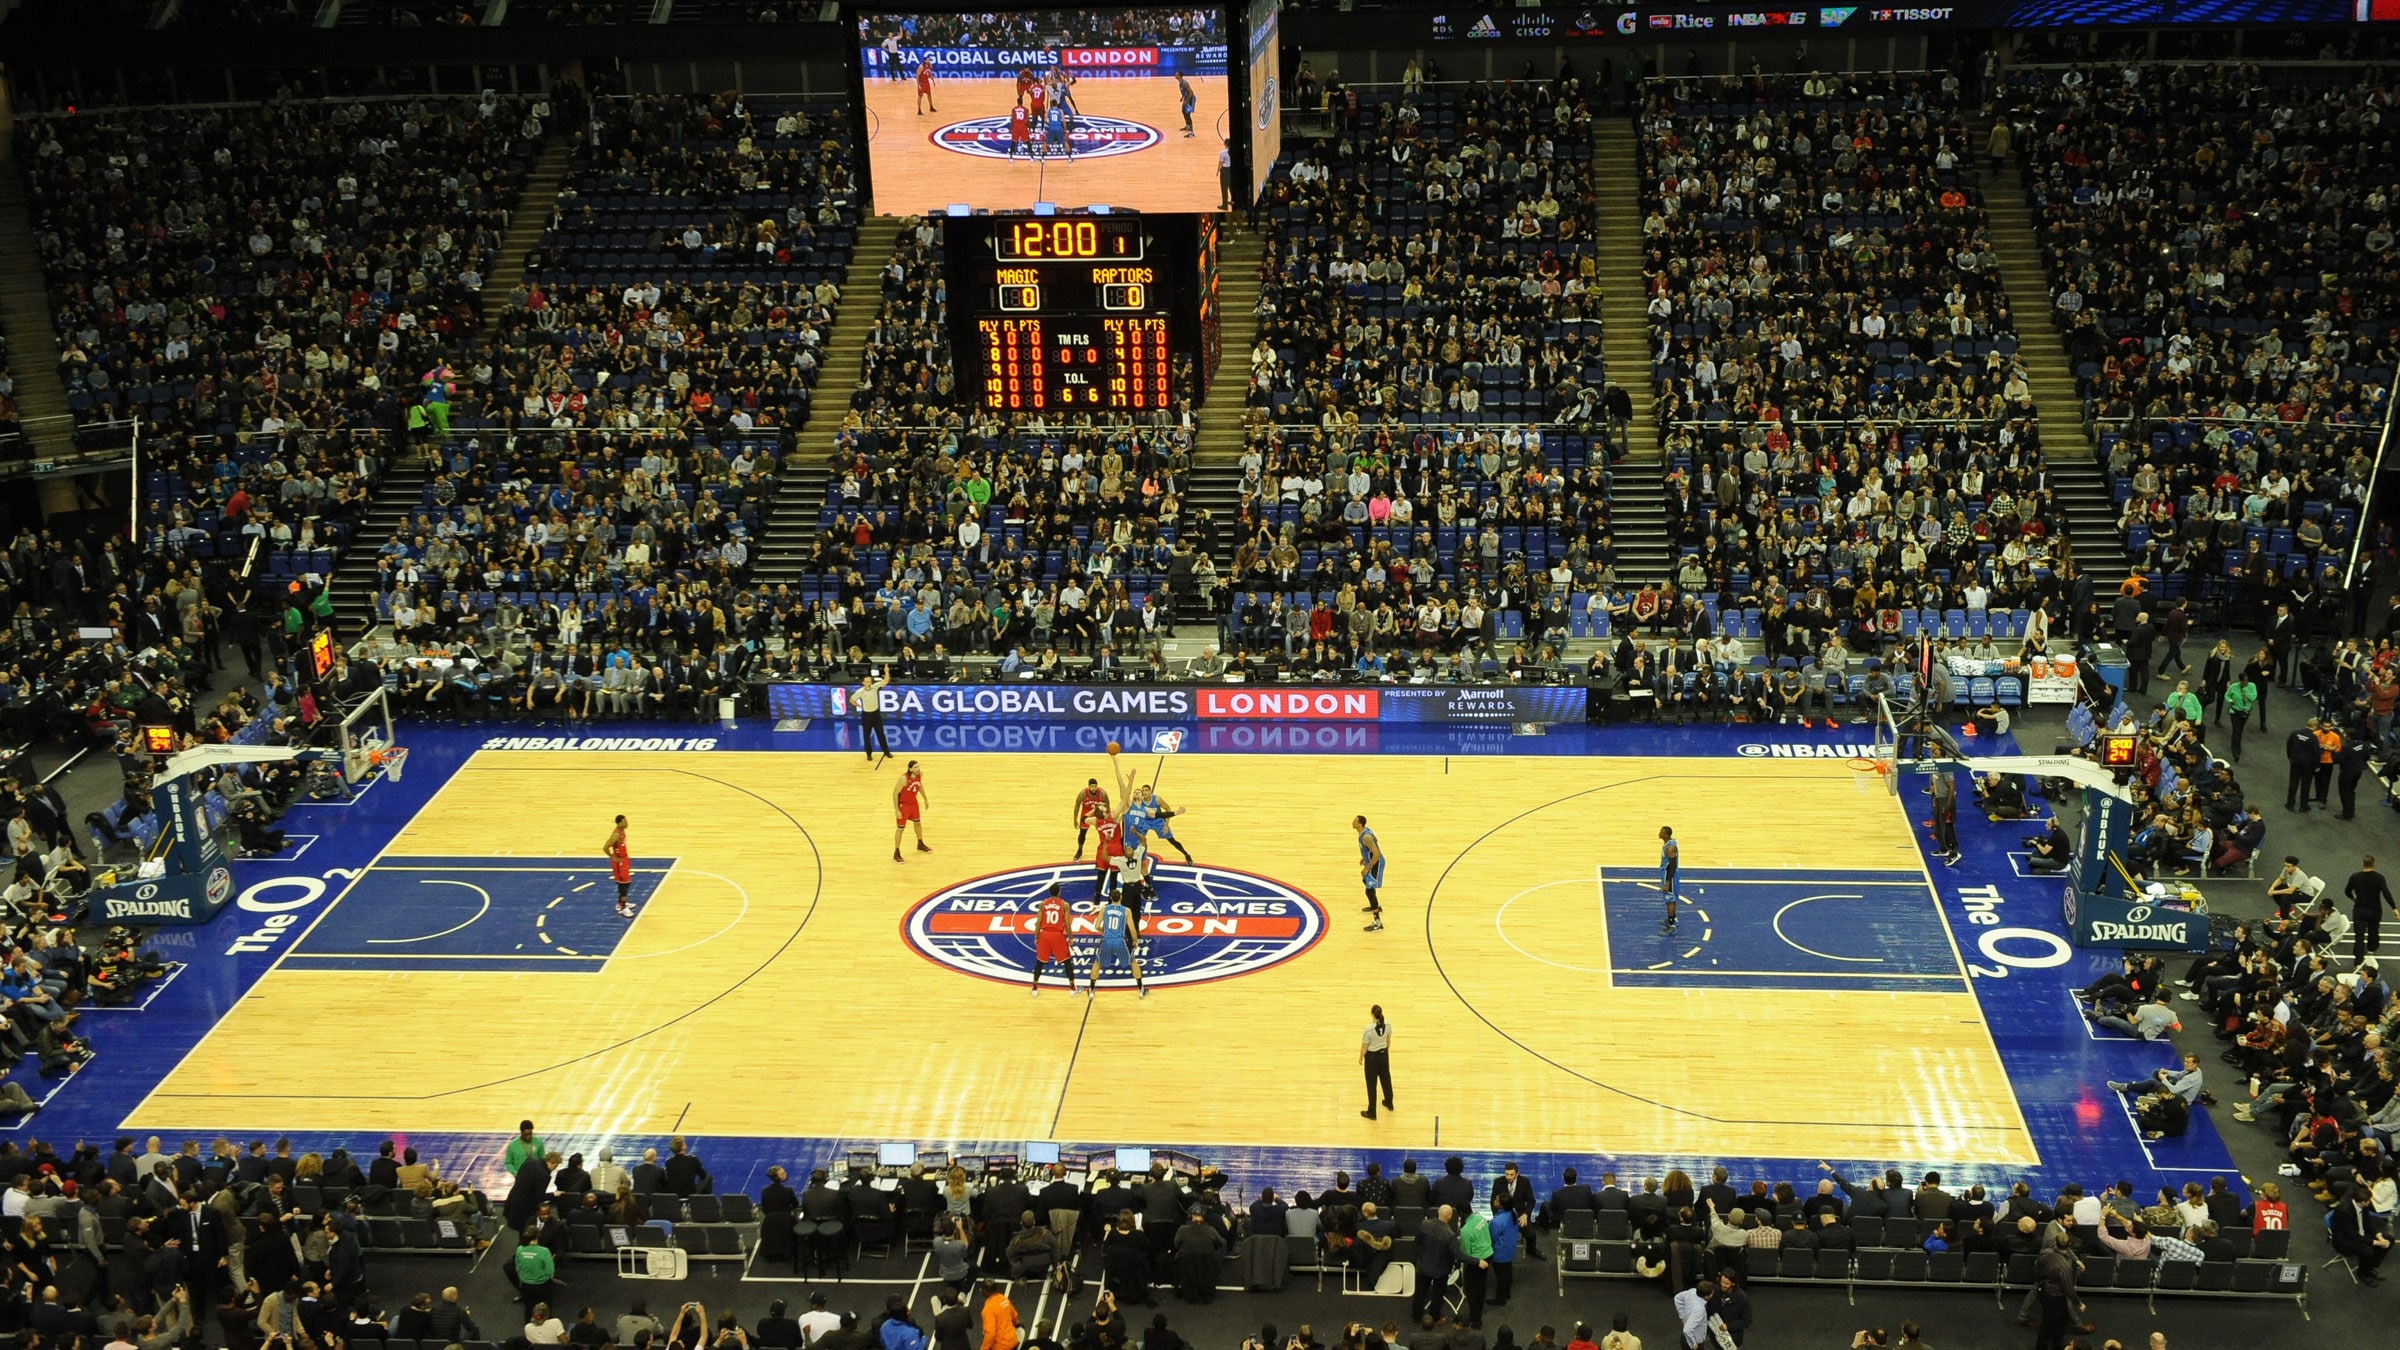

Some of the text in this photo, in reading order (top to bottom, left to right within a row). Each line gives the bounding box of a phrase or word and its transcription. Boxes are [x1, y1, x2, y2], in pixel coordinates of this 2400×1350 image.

[1675, 14, 1714, 28] Rice
[1821, 11, 1849, 24] SAP
[1893, 8, 1953, 20] TISSOT
[1616, 12, 1637, 34] G
[1467, 30, 1501, 38] adidas
[1516, 27, 1550, 36] CISCO
[928, 51, 994, 65] GLOBAL
[998, 50, 1058, 64] GAMES
[1068, 50, 1152, 64] LONDON
[1101, 223, 1133, 233] PERIOD
[1013, 222, 1097, 257] 12:00
[1118, 237, 1125, 254] 1
[996, 268, 1039, 284] MAGIC
[1093, 268, 1153, 284] RAPTORS
[1022, 287, 1035, 307] 0
[1128, 287, 1141, 306] 0
[979, 320, 1040, 332] PLY FL PTS
[1104, 319, 1165, 331] PLY FL PTS
[990, 331, 1041, 346] 5 0 0
[1057, 335, 1089, 345] TM FLS
[1115, 330, 1165, 345] 3 0 0
[991, 347, 1041, 361] 8 0 0
[1061, 350, 1096, 363] 0 0
[1115, 346, 1166, 360] 4 0 0
[991, 363, 1042, 376] 9 0 0
[1116, 362, 1166, 375] 7 0 0
[987, 378, 1043, 392] 10 0 0
[1064, 373, 1088, 384] T.O.L.
[1111, 377, 1166, 391] 10 0 0
[988, 394, 1044, 408] 12 0 0
[1063, 388, 1098, 402] 6 6
[1112, 393, 1167, 407] 17 0 0
[857, 689, 1188, 714] BA GLOBAL GAMES
[1457, 689, 1504, 700] Marriott
[1208, 693, 1366, 715] LONDON
[481, 737, 718, 750] #NBALONDON16
[2109, 749, 2128, 761] 24
[167, 783, 185, 843] @NBAUK
[2096, 797, 2113, 861] @NBAUK
[105, 898, 192, 919] SPALDING
[950, 899, 1019, 912] NBA
[1171, 901, 1287, 915] GAMES
[1957, 884, 2004, 925] The
[1045, 910, 1059, 924] 10
[1108, 916, 1119, 930] 10
[988, 916, 1239, 934] LNON
[2090, 920, 2187, 943] SPALDING
[225, 914, 298, 956] The
[2263, 1216, 2282, 1230] 10
